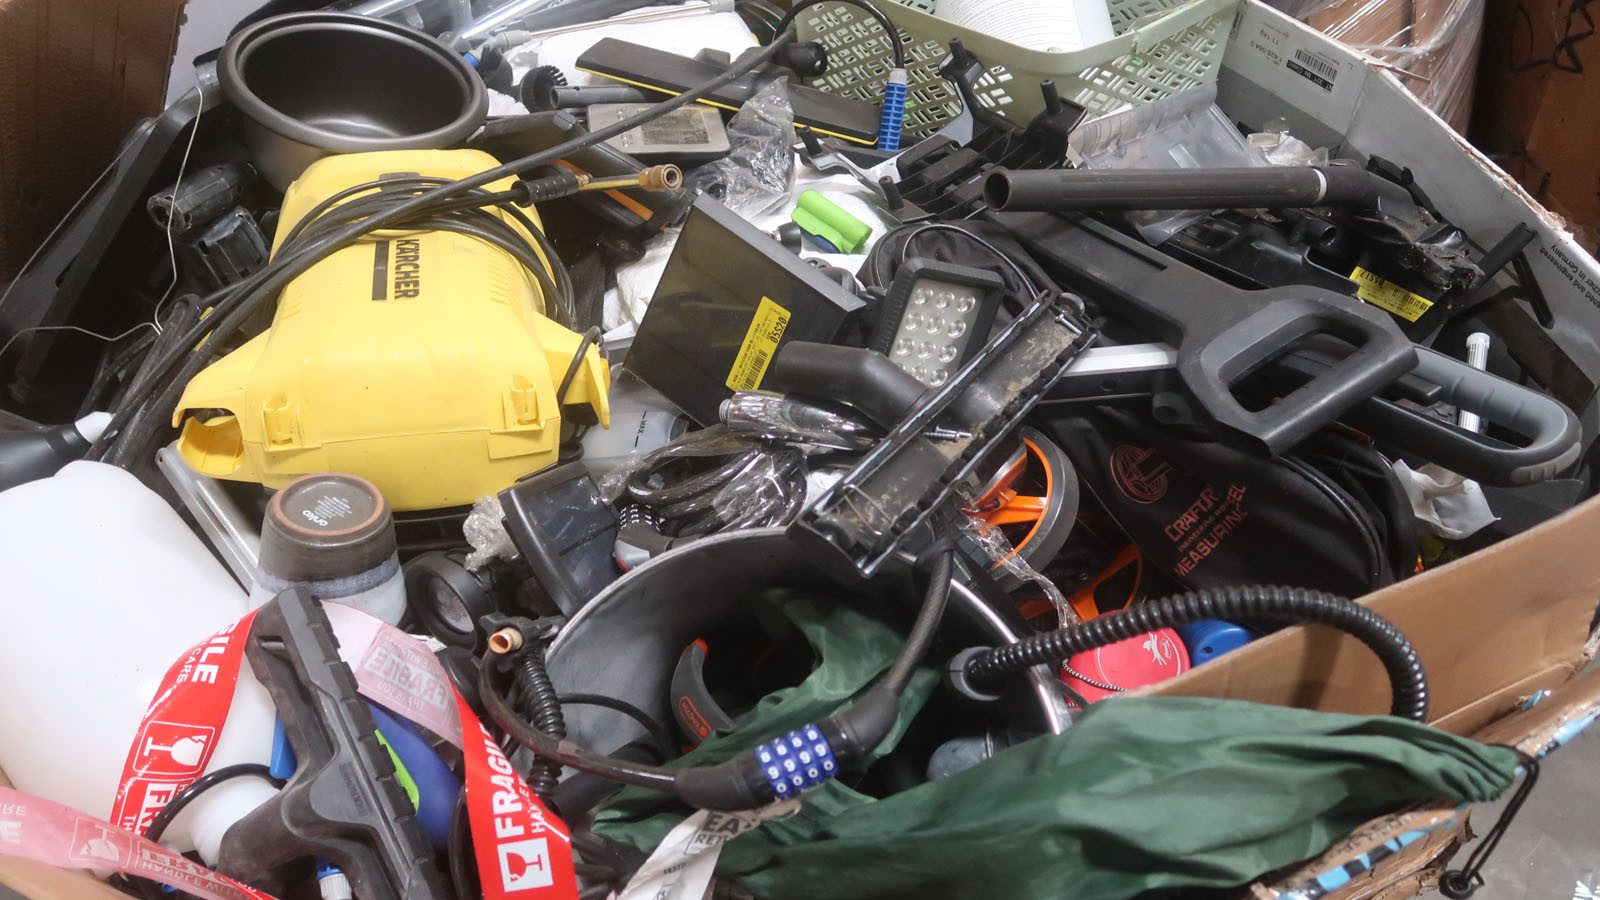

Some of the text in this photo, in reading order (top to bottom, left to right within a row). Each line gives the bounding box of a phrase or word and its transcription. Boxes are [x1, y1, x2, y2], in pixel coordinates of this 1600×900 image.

[394, 239, 420, 300] KÄRCHER
[1551, 244, 1579, 274] Germany
[1573, 280, 1586, 293] and
